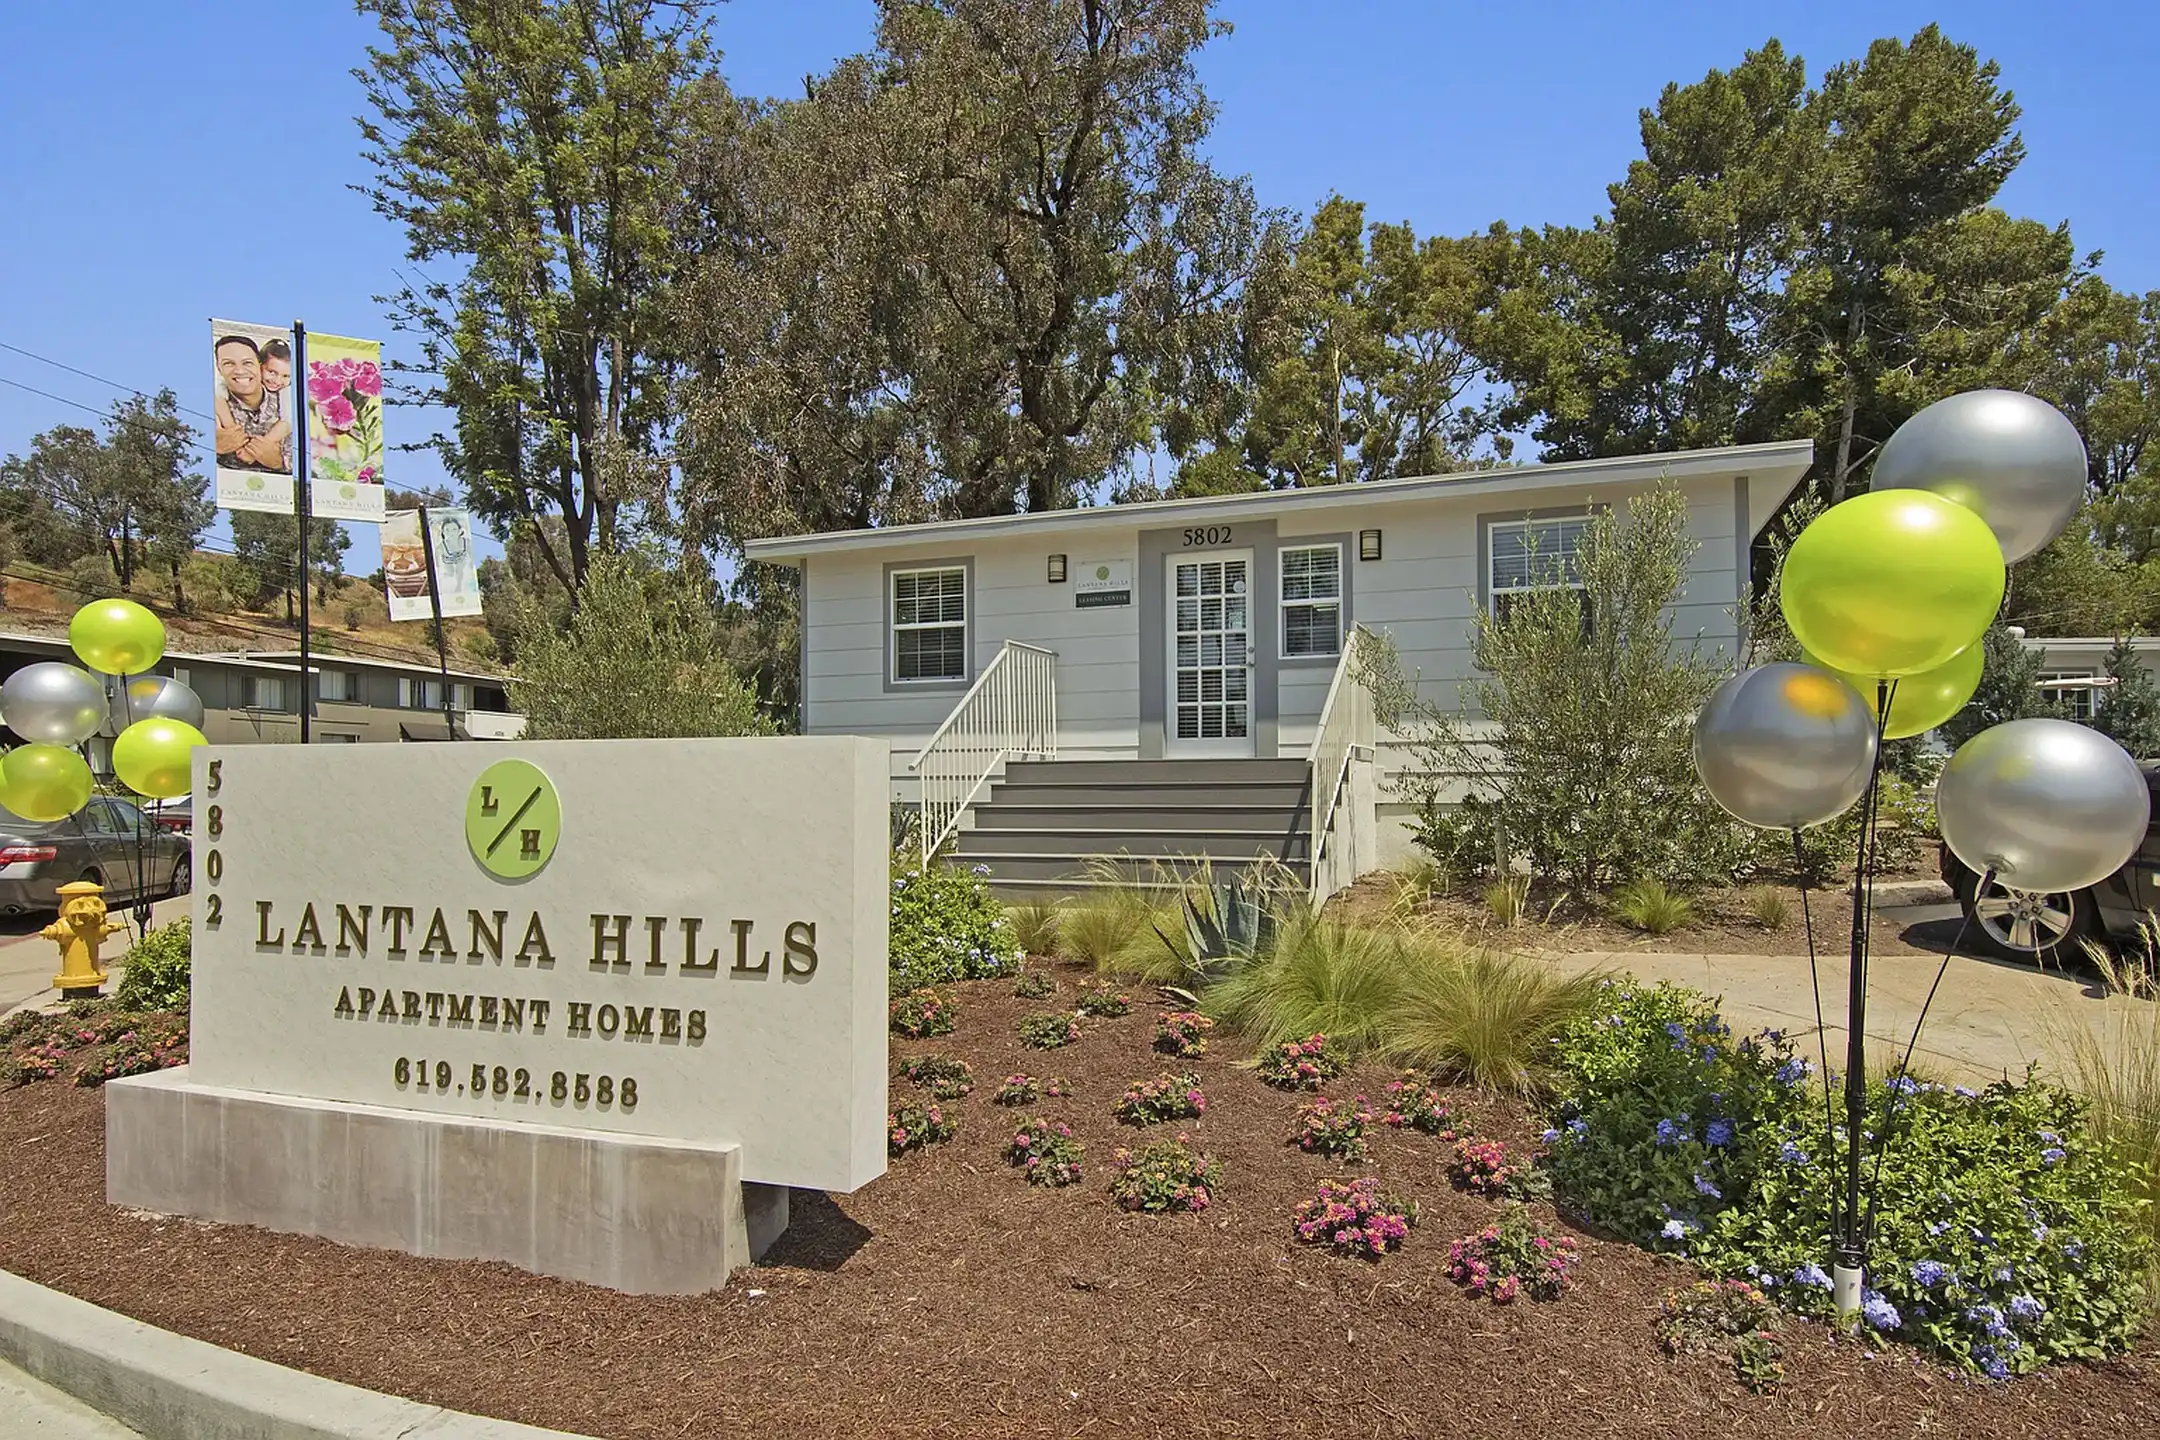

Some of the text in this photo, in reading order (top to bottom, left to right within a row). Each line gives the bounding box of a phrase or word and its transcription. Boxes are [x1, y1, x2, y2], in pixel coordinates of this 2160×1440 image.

[1183, 526, 1233, 547] 5802
[206, 759, 223, 926] 5802
[255, 900, 819, 976] LANTANA HILLS
[334, 985, 707, 1041] APARTMENT HOMES
[394, 1057, 638, 1107] 619.582.8588
